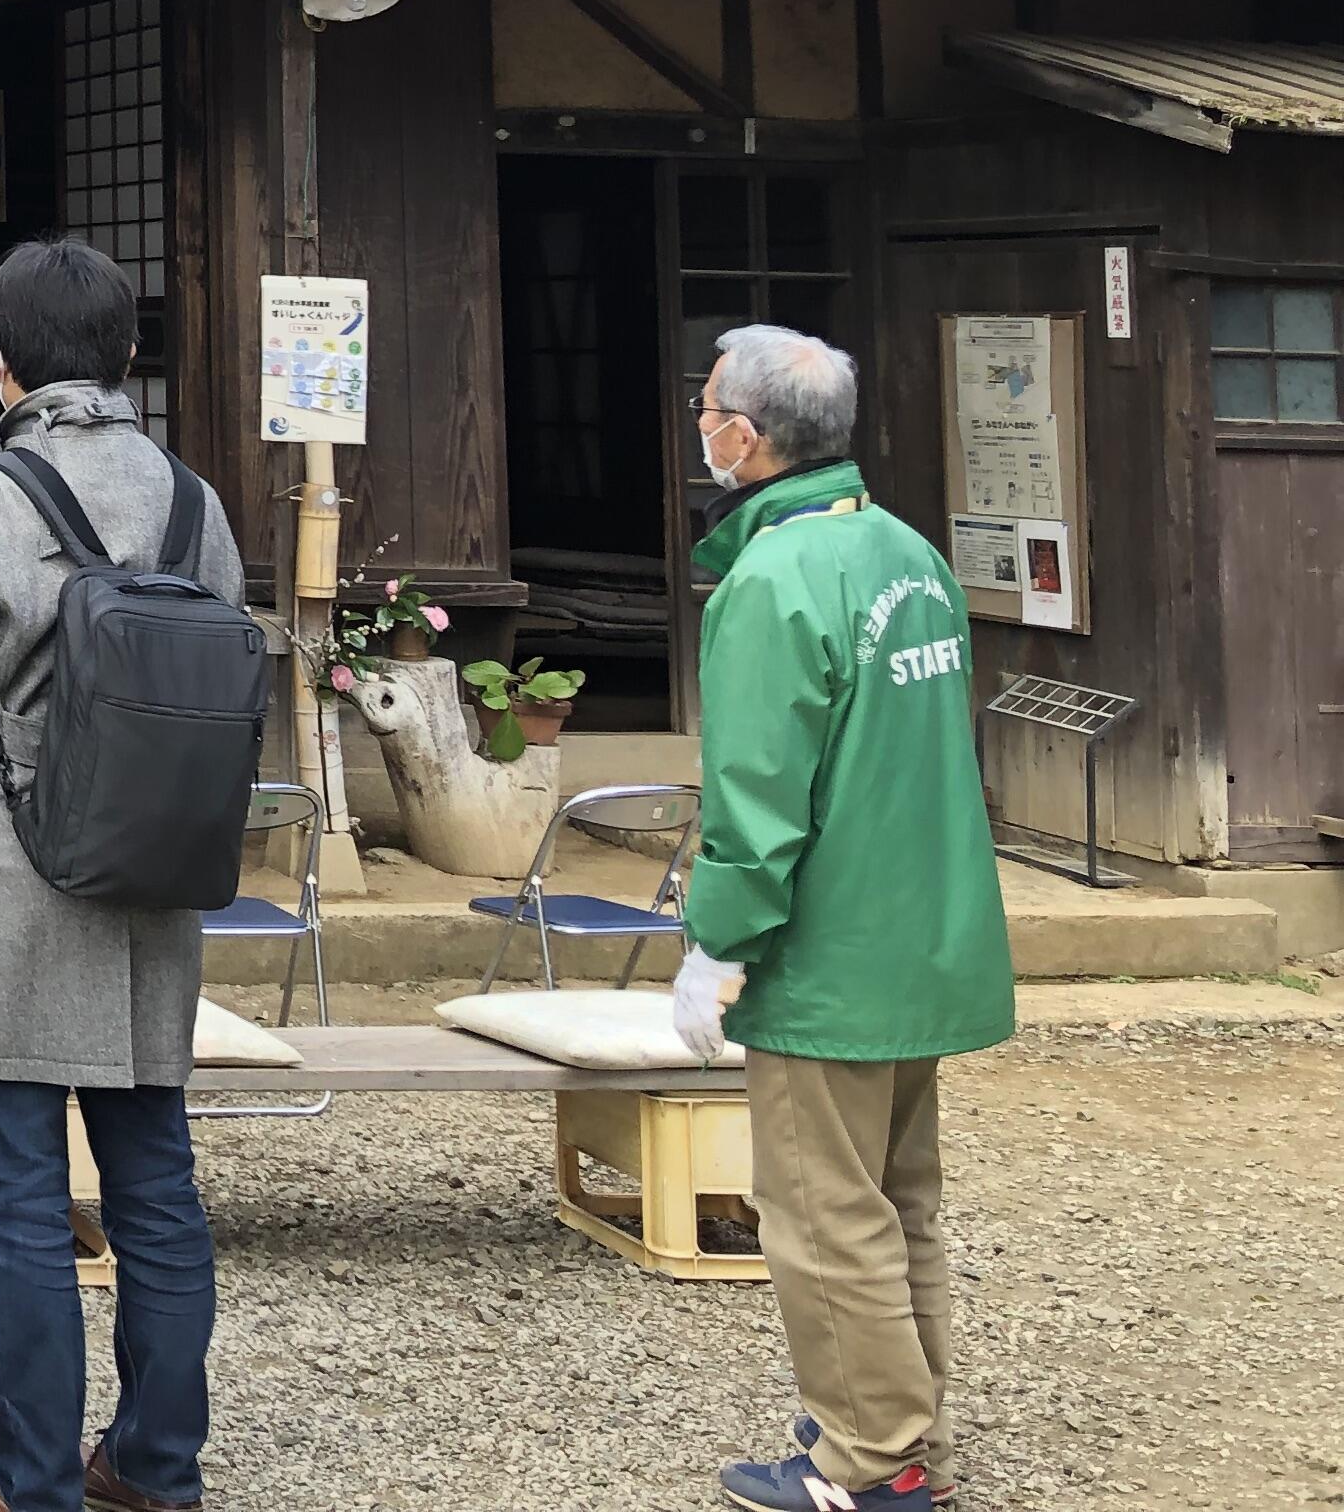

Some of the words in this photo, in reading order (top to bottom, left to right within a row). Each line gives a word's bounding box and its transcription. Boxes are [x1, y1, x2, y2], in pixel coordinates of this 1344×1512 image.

[271, 310, 351, 321] すいしゃくんバッジ
[1111, 255, 1124, 331] 火気厳禁
[890, 636, 962, 686] STAFF
